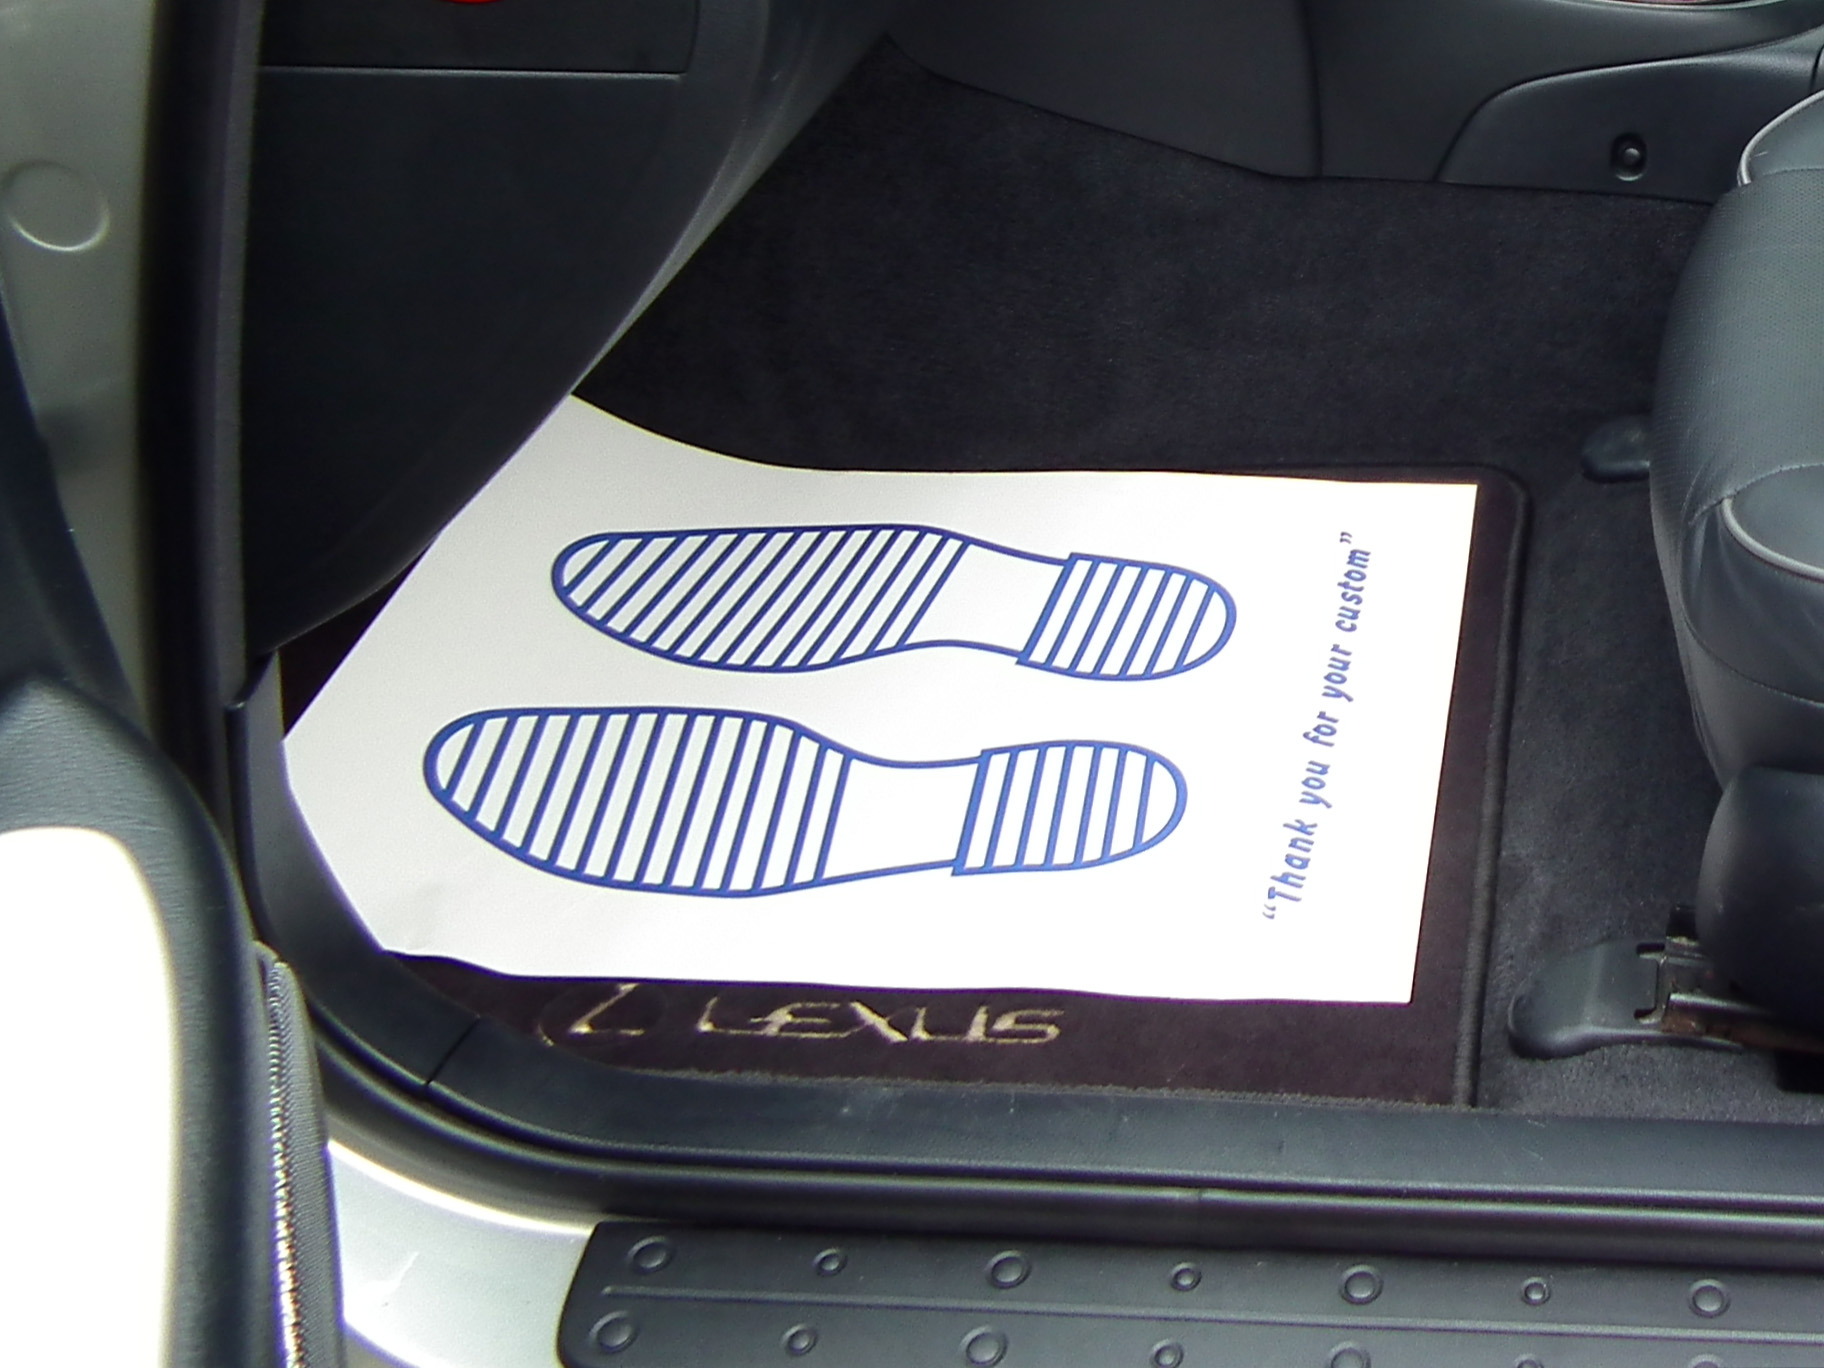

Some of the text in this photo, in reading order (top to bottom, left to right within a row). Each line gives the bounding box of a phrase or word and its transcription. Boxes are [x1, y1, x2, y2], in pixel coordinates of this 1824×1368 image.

[1321, 644, 1354, 703] your
[1302, 711, 1340, 748] for
[1299, 760, 1333, 809] you
[697, 996, 1066, 1044] LEXUS
